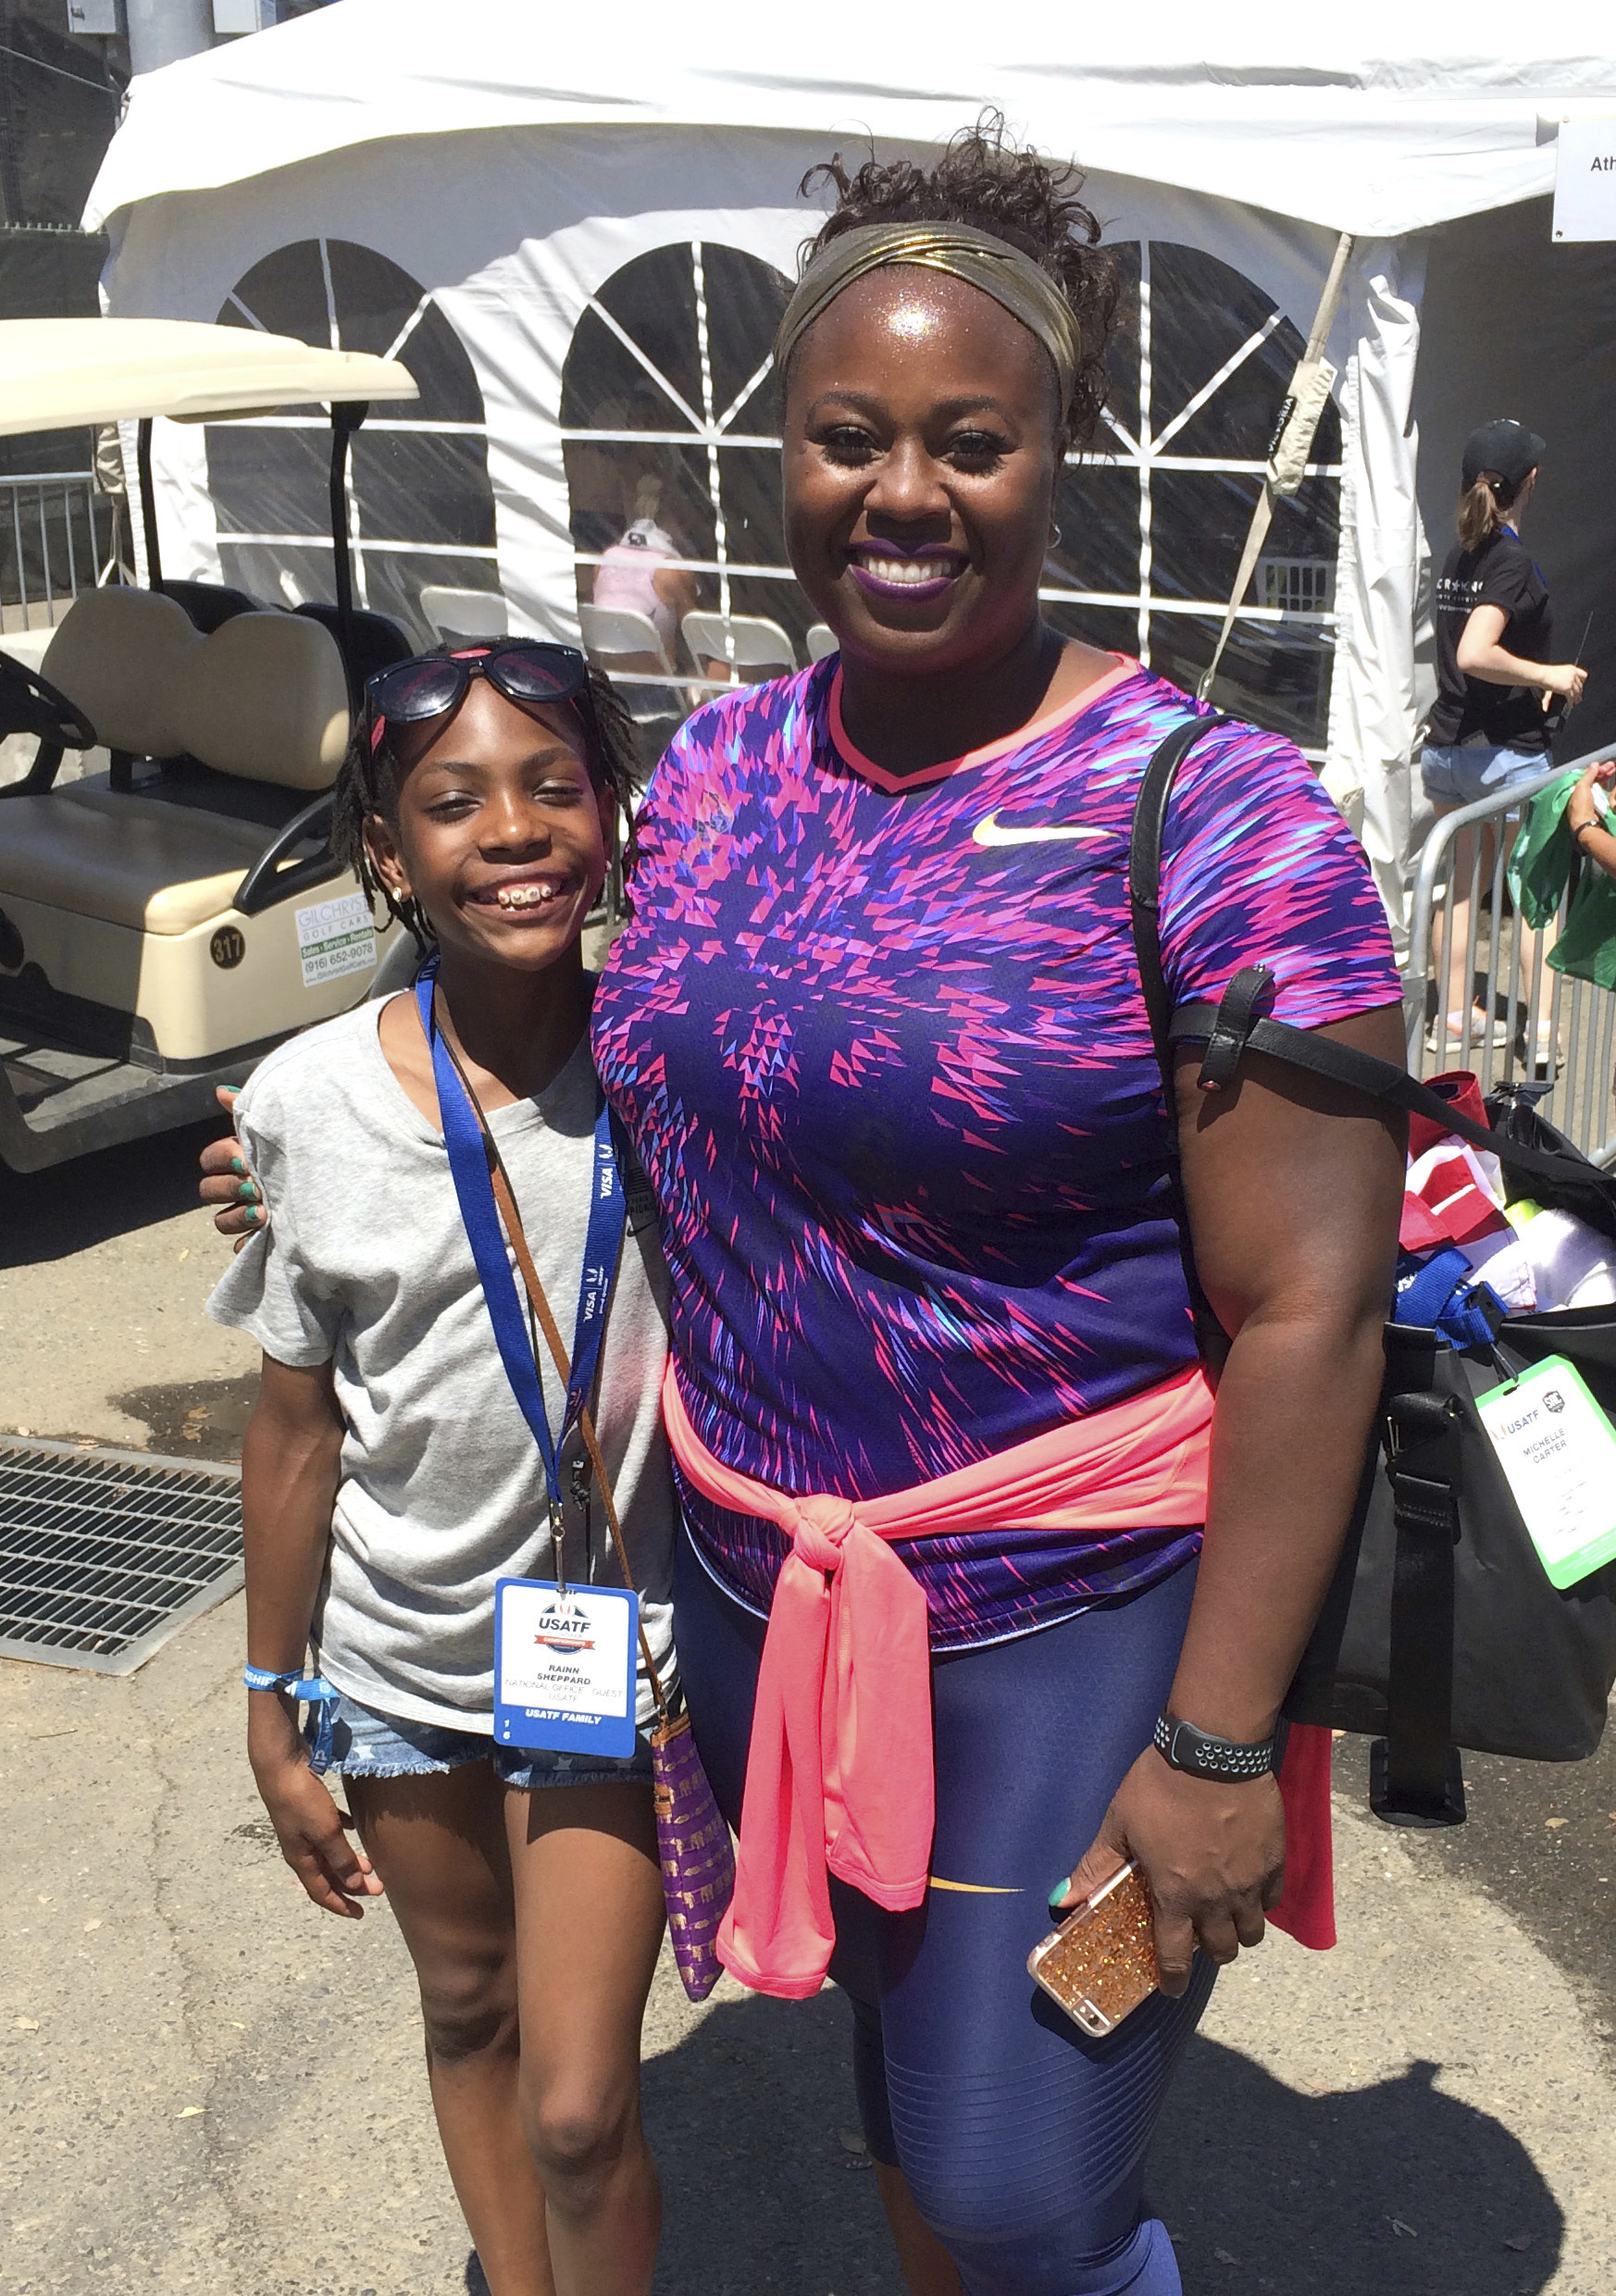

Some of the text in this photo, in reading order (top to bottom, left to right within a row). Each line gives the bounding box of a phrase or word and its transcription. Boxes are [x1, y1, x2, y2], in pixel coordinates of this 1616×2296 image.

[304, 914, 369, 941] GOLF CARS
[213, 934, 241, 962] 317
[305, 943, 374, 974] (916) 652-9078
[600, 1167, 613, 1199] VISA
[583, 1291, 597, 1322] VISA
[1507, 1409, 1538, 1434] USATF
[1523, 1428, 1566, 1458] MICHELLE
[1533, 1439, 1567, 1464] CARTER
[539, 1617, 591, 1633] USATF
[537, 1672, 591, 1685] SHEPPARD
[548, 1664, 580, 1674] RAINN
[504, 1678, 623, 1698] NATIONAL OFFICE GUEST
[548, 1693, 578, 1702] USATF
[503, 1719, 510, 1728] 1
[525, 1708, 603, 1725] USATF FAMILY
[503, 1731, 511, 1740] 6
